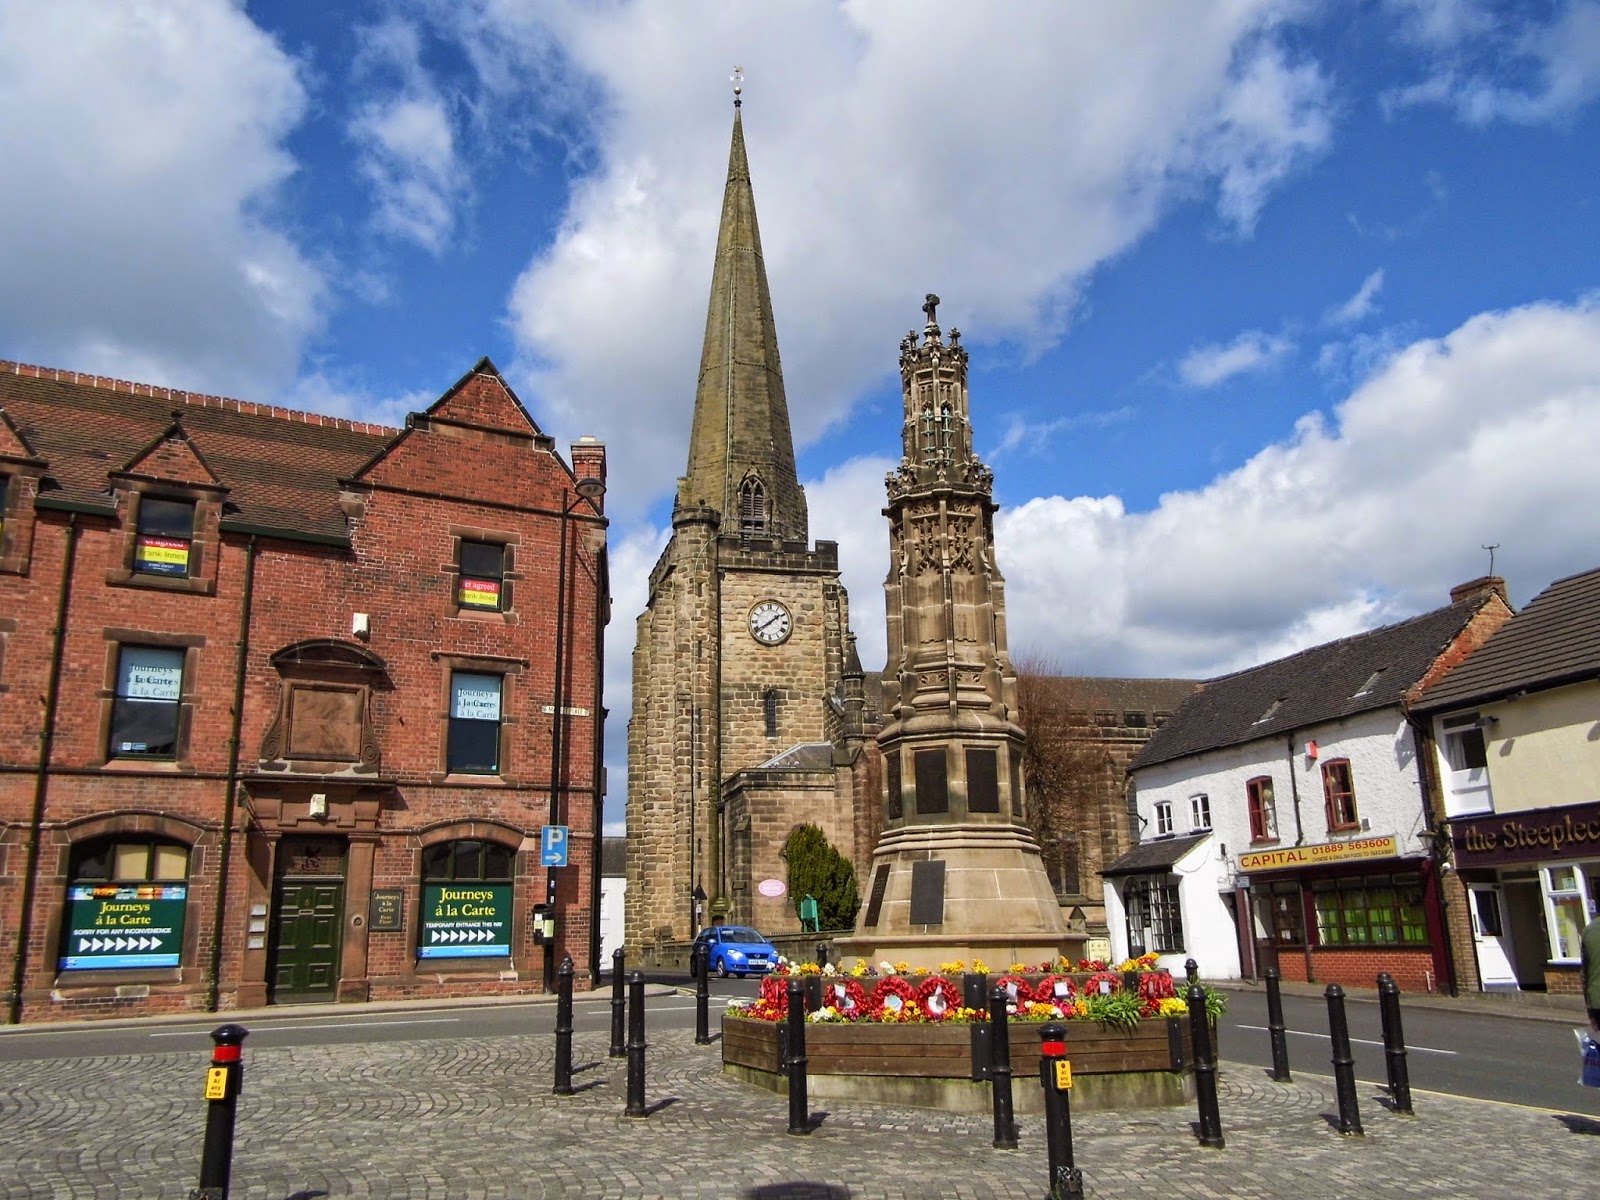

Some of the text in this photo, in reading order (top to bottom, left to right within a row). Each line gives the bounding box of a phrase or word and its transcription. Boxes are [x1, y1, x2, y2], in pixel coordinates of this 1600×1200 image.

[548, 828, 564, 850] P
[1464, 814, 1600, 850] the Steeplec
[1240, 838, 1390, 868] CAPITAL 01889 563600
[439, 888, 494, 903] Journeys
[100, 902, 150, 914] Journeys
[436, 904, 496, 916] à la Carte
[96, 914, 152, 925] à la Carte
